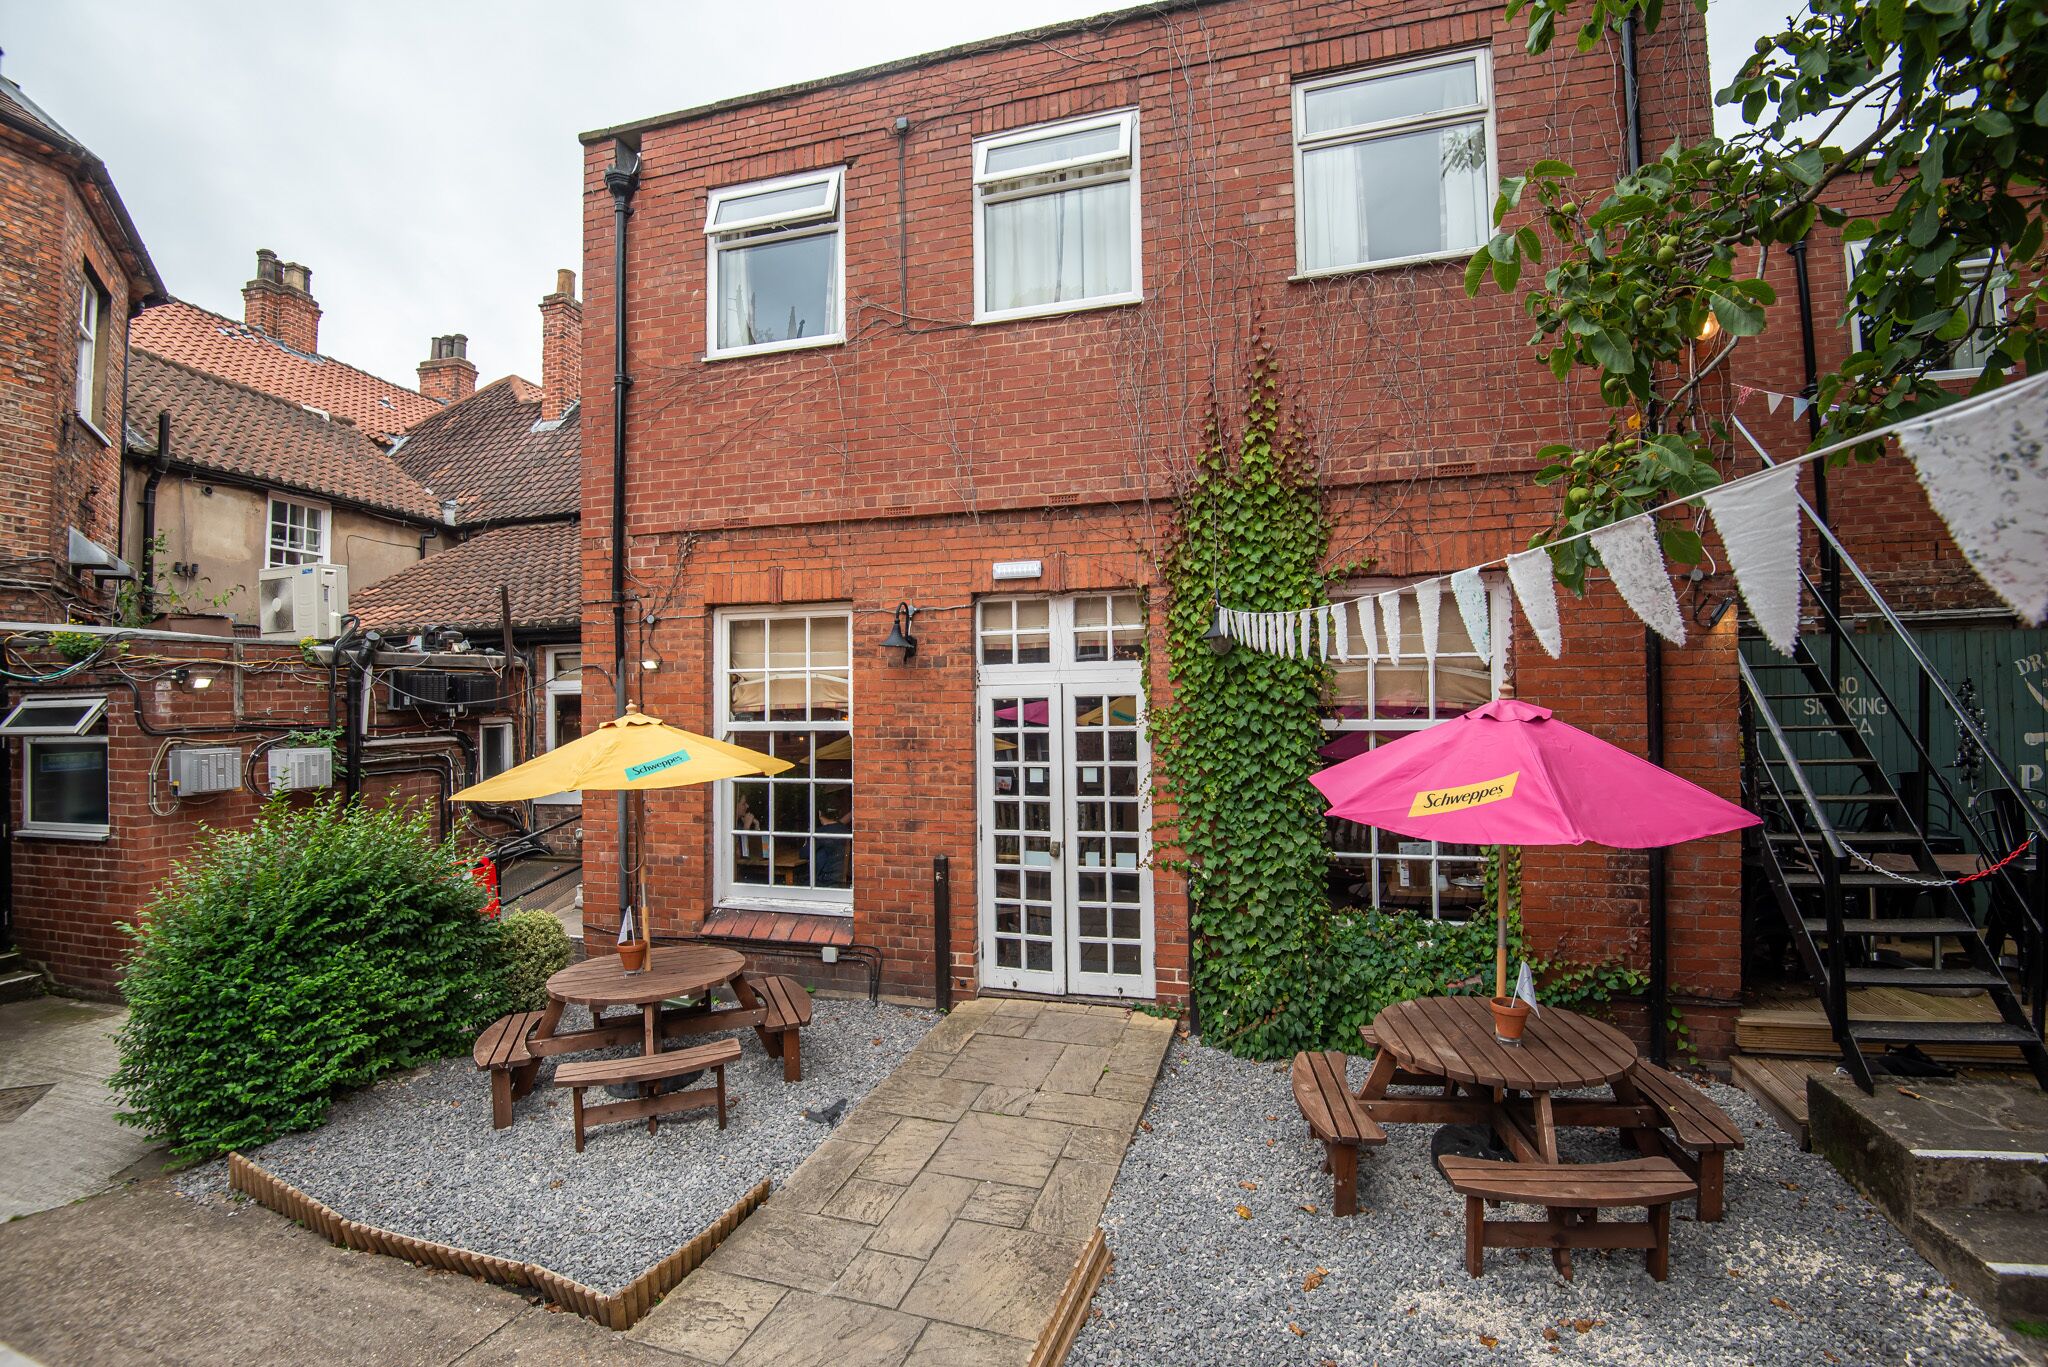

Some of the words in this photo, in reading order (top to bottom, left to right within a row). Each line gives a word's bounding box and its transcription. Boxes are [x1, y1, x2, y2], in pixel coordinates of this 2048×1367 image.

[1817, 718, 1875, 737] AA
[632, 755, 682, 776] Schweppes
[1423, 784, 1504, 808] Schweppes
